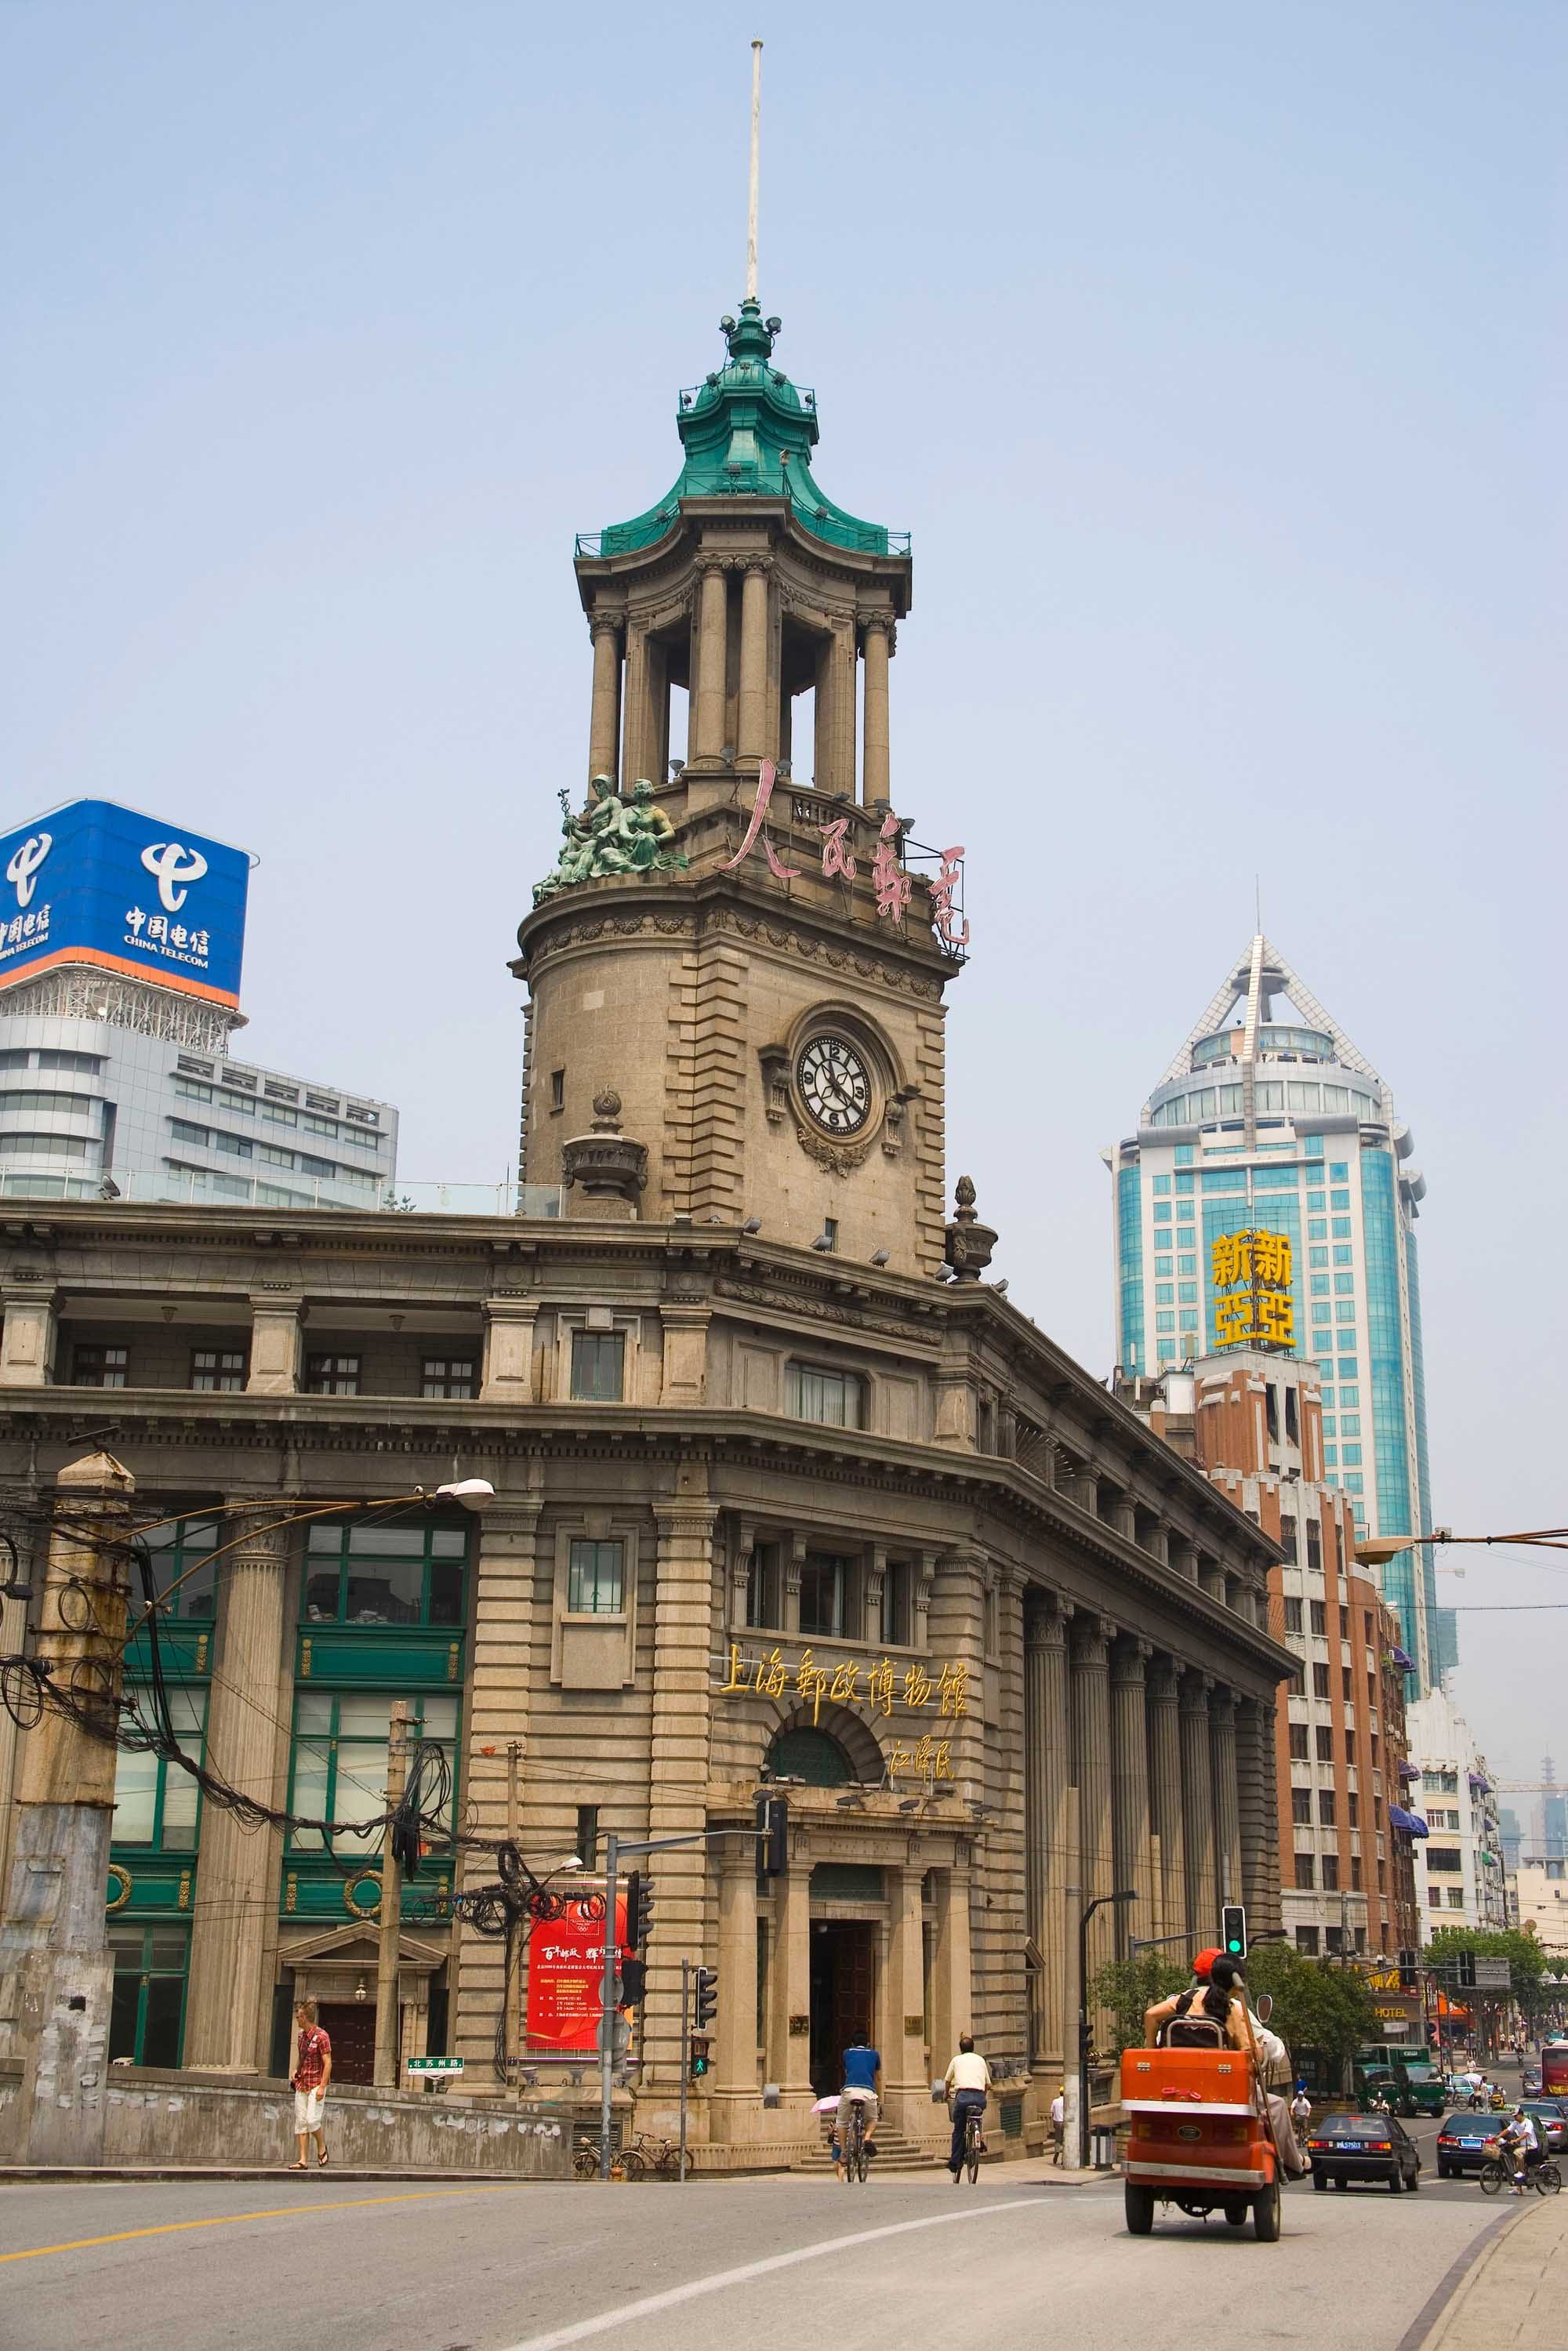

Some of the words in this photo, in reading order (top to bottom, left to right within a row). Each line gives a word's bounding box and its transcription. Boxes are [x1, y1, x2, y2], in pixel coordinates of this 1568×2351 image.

[125, 906, 210, 956] 中国电信
[124, 934, 158, 952] CHINA
[159, 945, 209, 969] TELECOM
[855, 1086, 865, 1100] 3
[1374, 2008, 1407, 2019] HOTEL
[414, 2059, 458, 2068] 北苏州路
